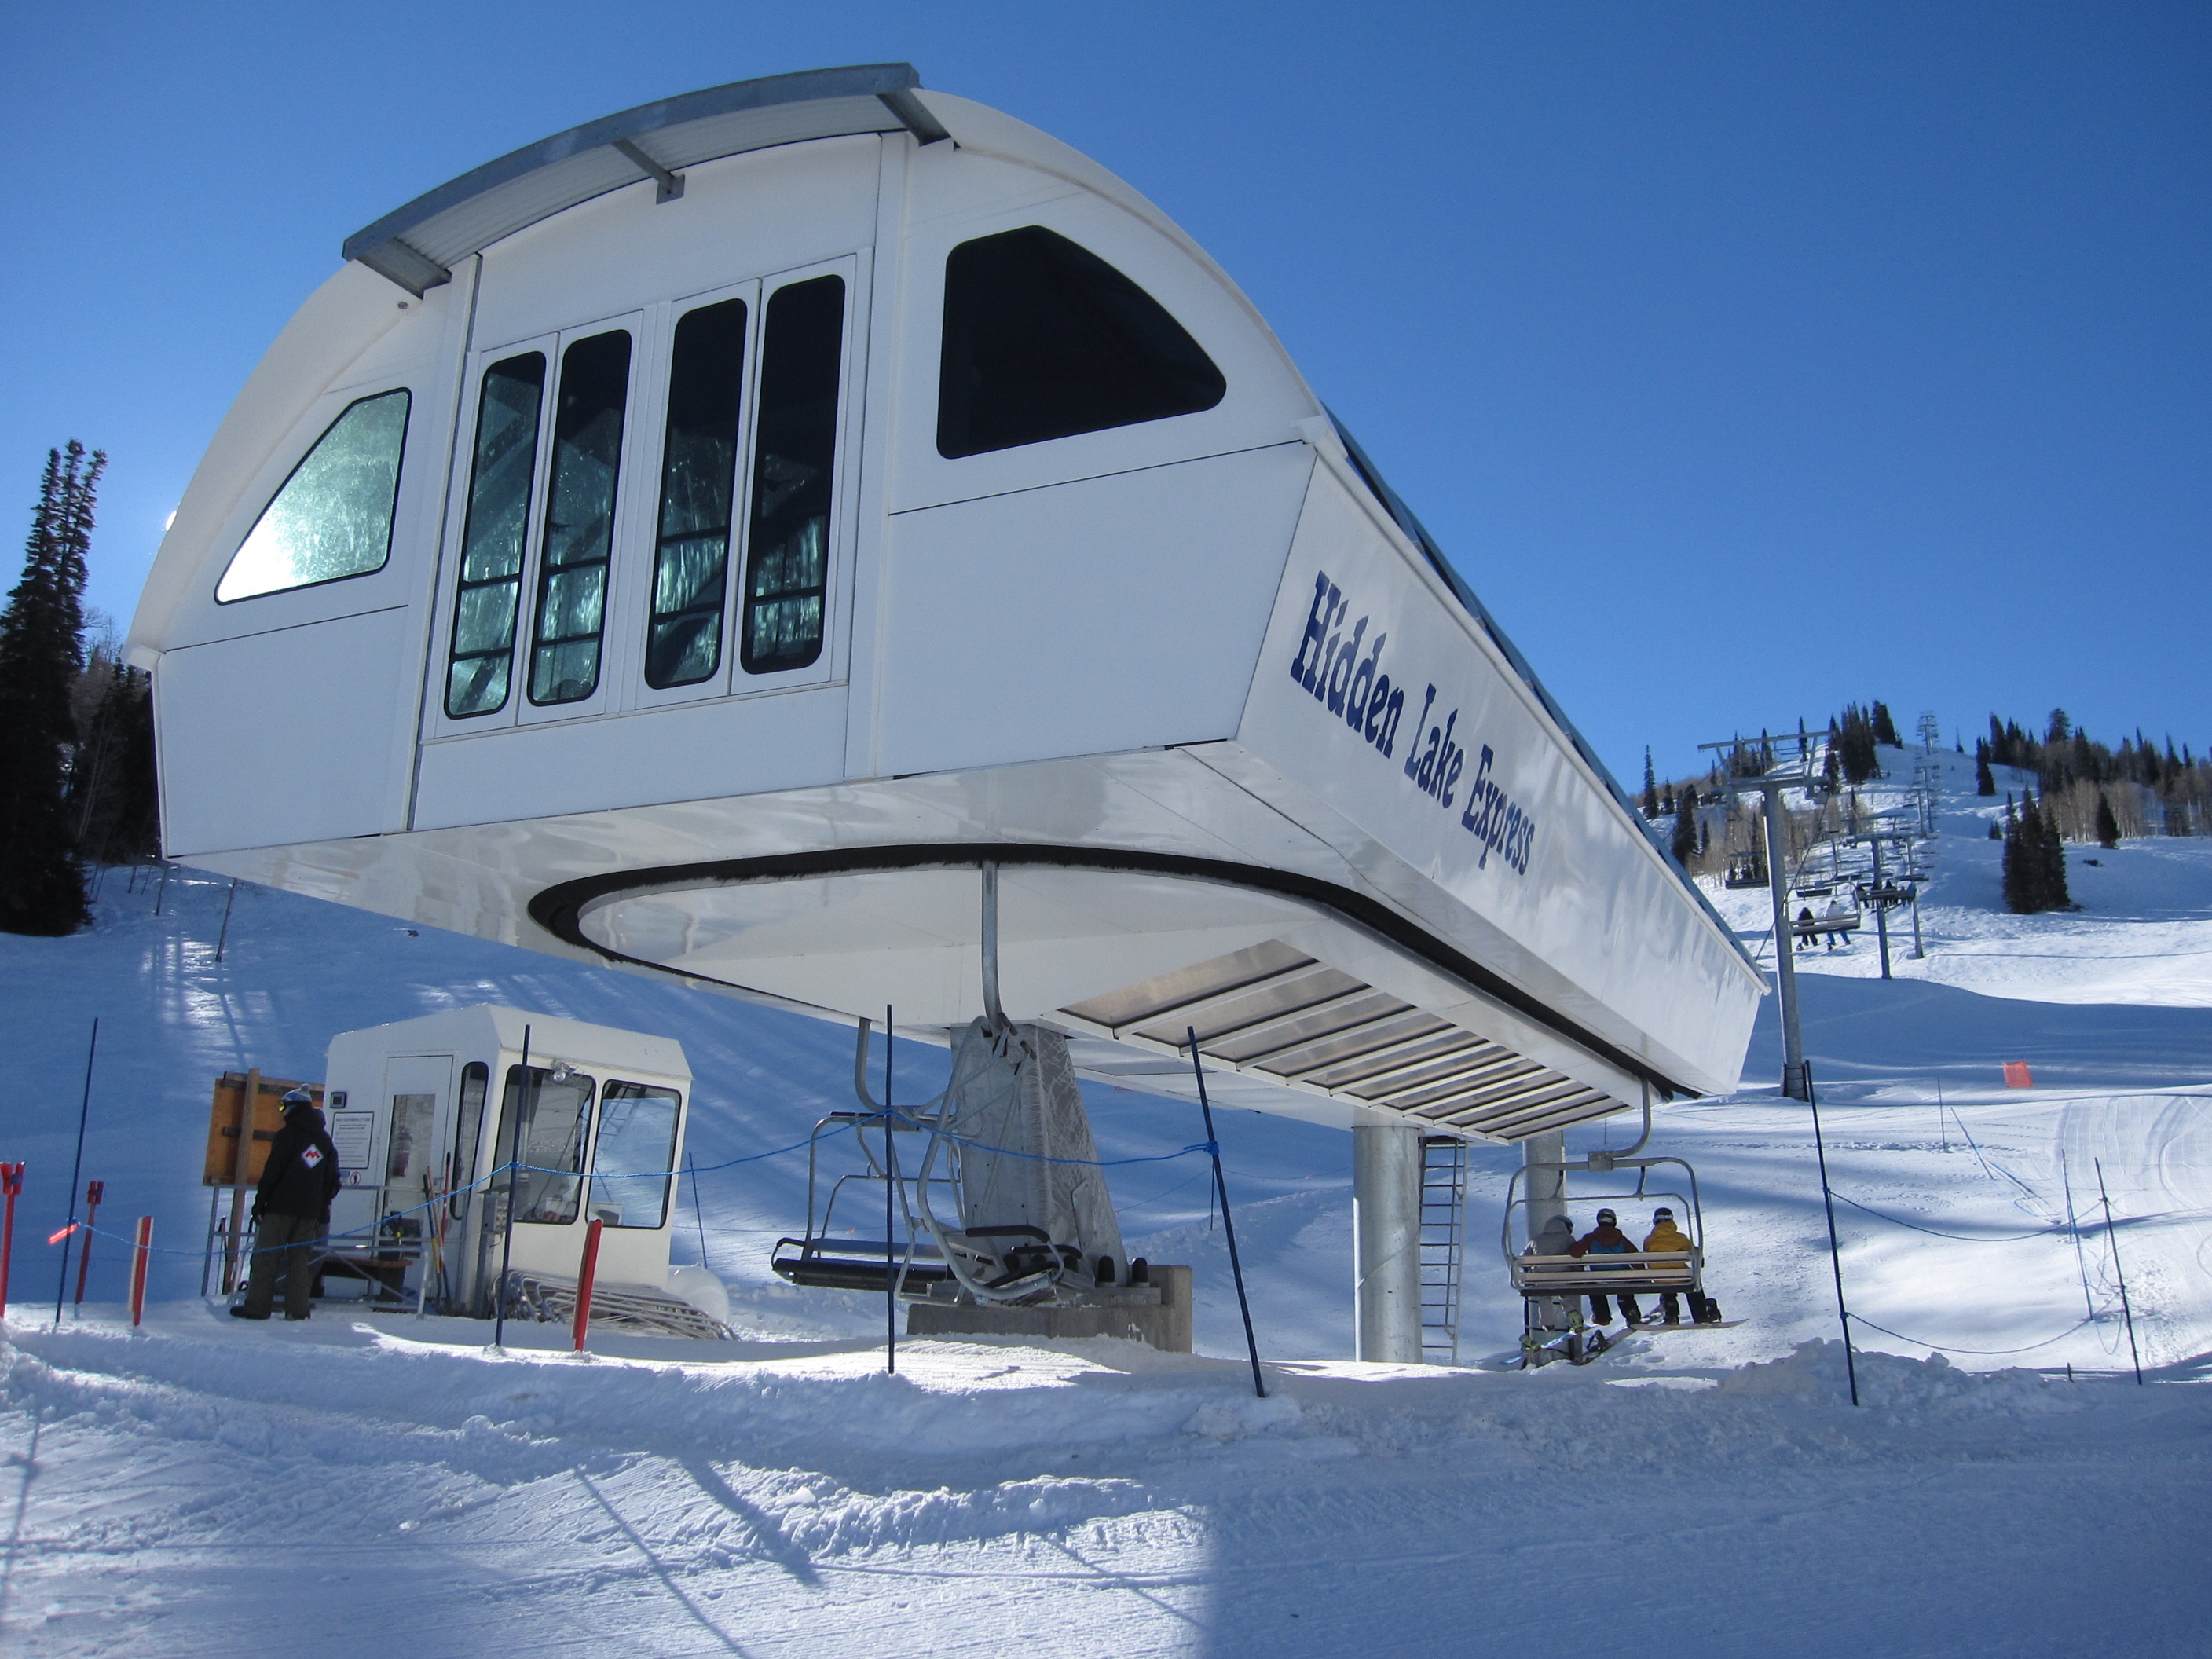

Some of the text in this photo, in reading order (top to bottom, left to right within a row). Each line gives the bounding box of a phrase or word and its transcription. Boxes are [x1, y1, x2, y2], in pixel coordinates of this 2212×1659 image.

[1290, 569, 1536, 877] Hidden Lake Express
